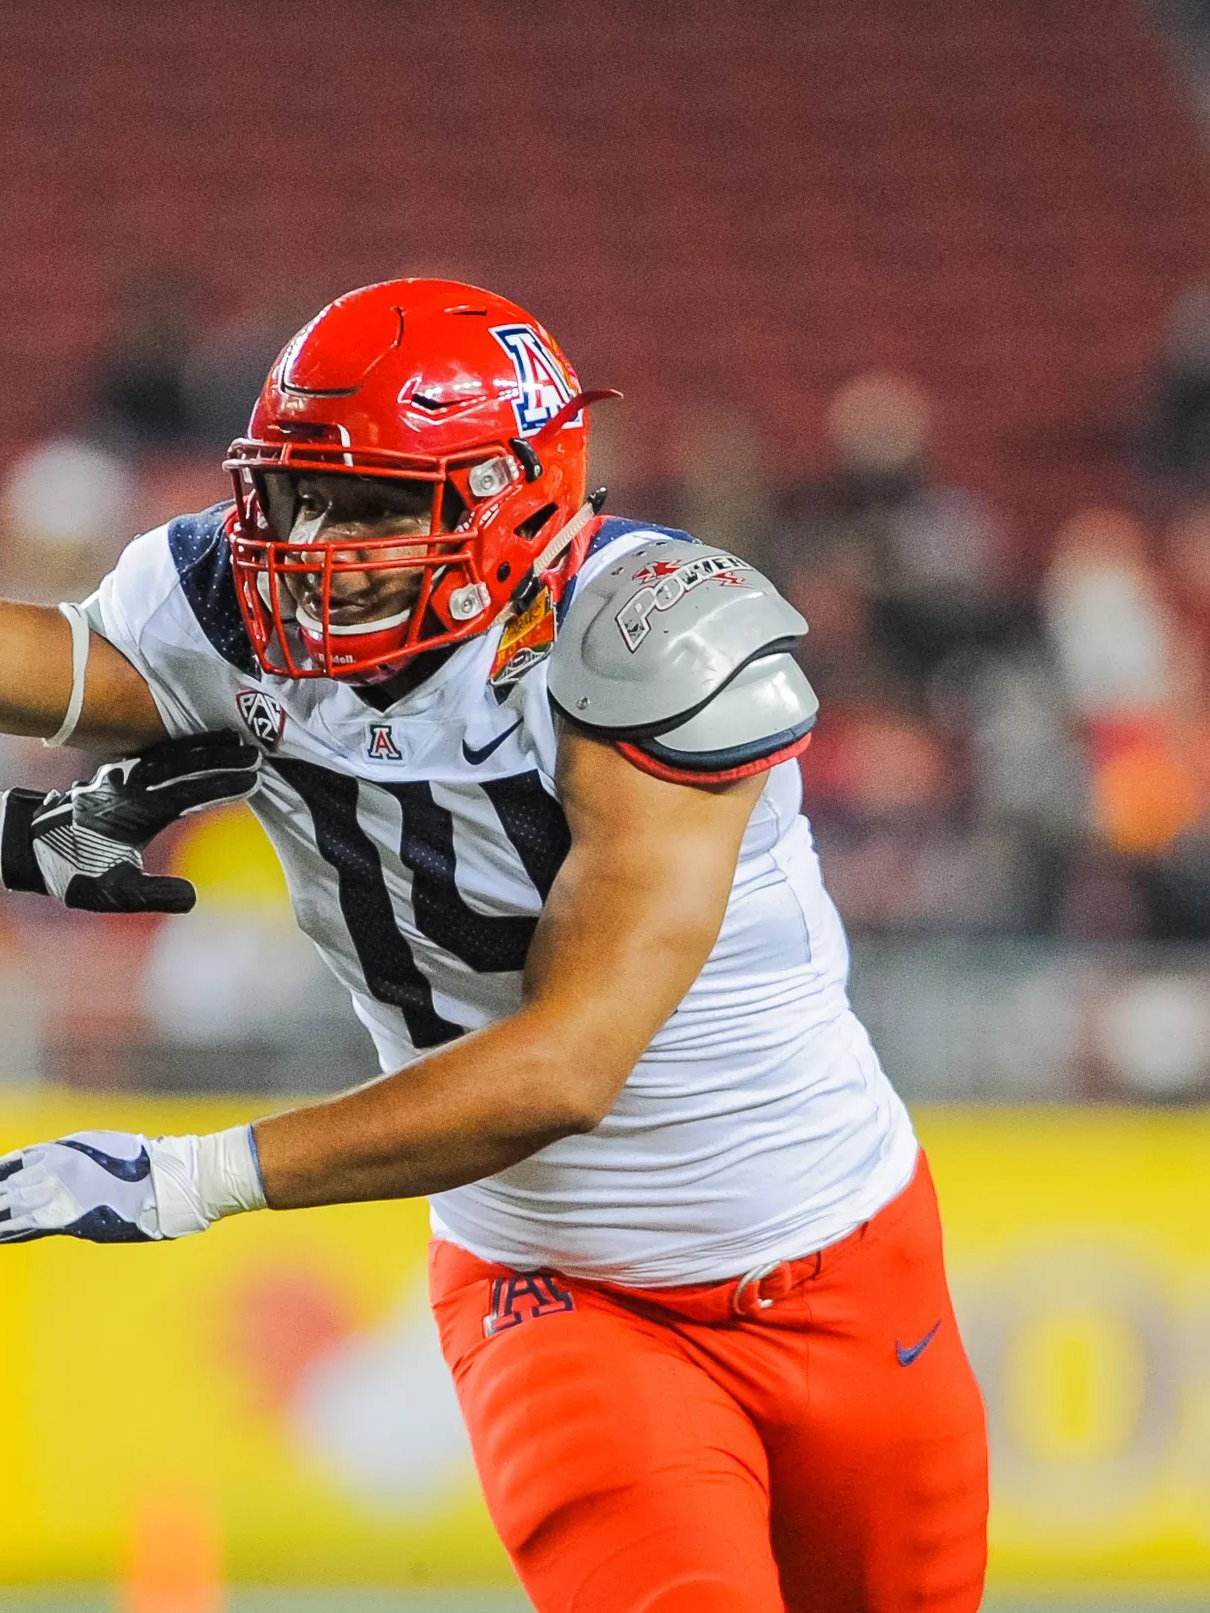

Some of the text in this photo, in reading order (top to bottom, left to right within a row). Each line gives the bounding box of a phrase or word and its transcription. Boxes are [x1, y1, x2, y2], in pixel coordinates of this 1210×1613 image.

[488, 323, 584, 438] A
[253, 717, 274, 742] 12
[366, 724, 404, 760] A
[482, 1273, 574, 1338] A
